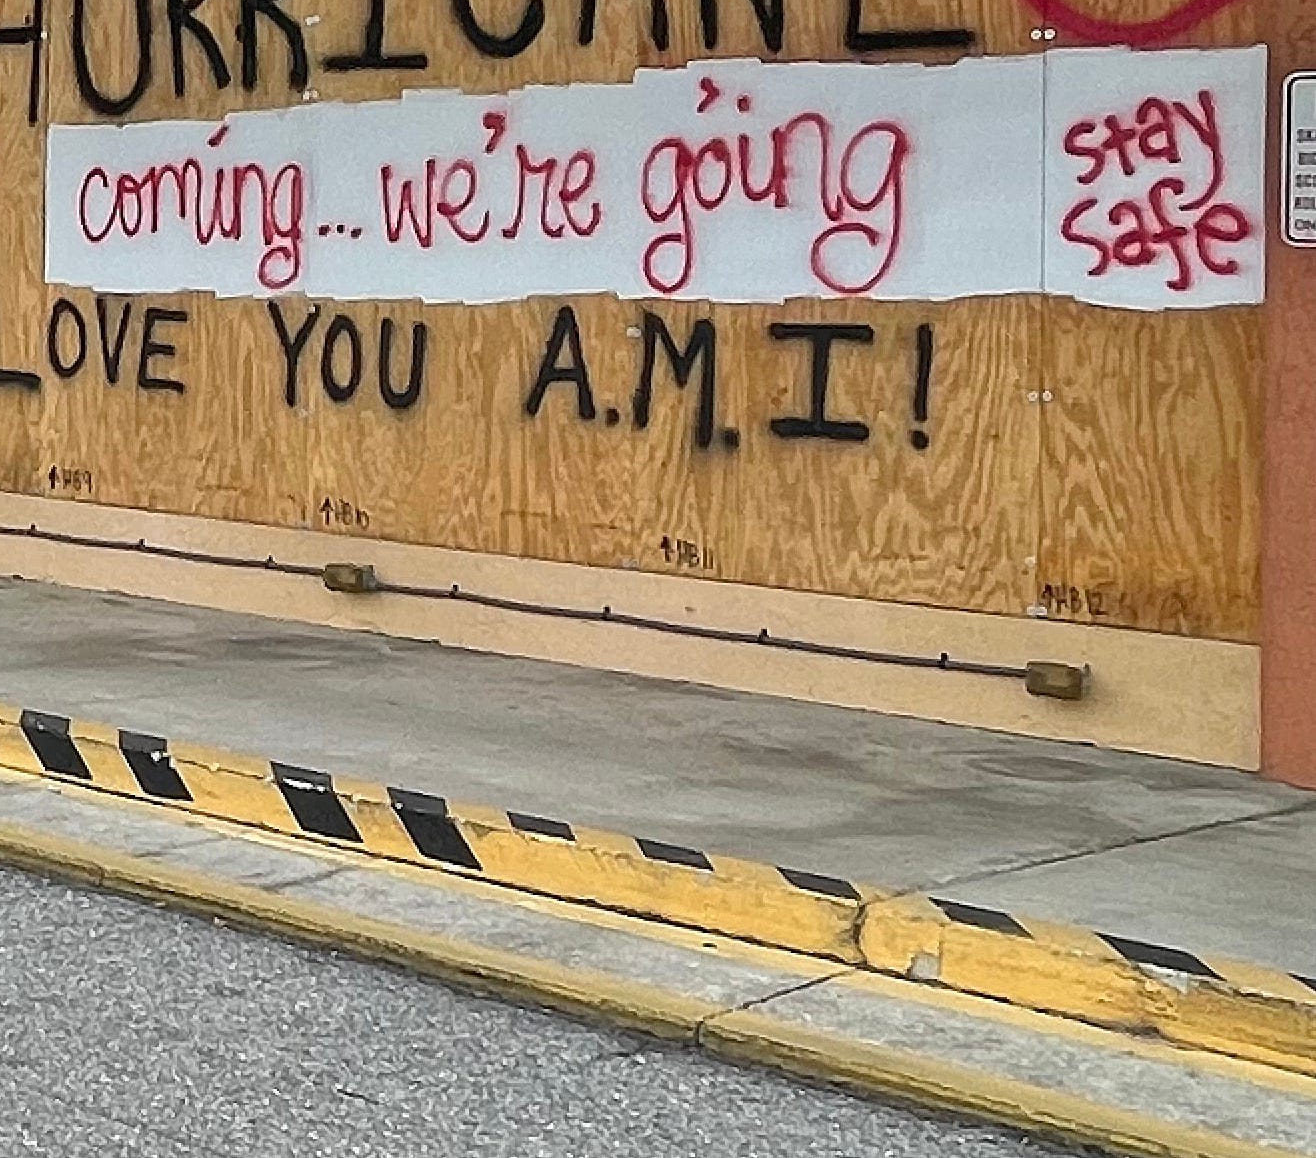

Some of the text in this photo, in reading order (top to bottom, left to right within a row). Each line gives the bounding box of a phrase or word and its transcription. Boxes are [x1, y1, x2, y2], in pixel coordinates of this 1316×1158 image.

[379, 112, 601, 247] we're
[639, 78, 914, 296] going
[1062, 88, 1228, 212] stay
[1060, 178, 1252, 292] safe
[267, 298, 428, 410] YOU
